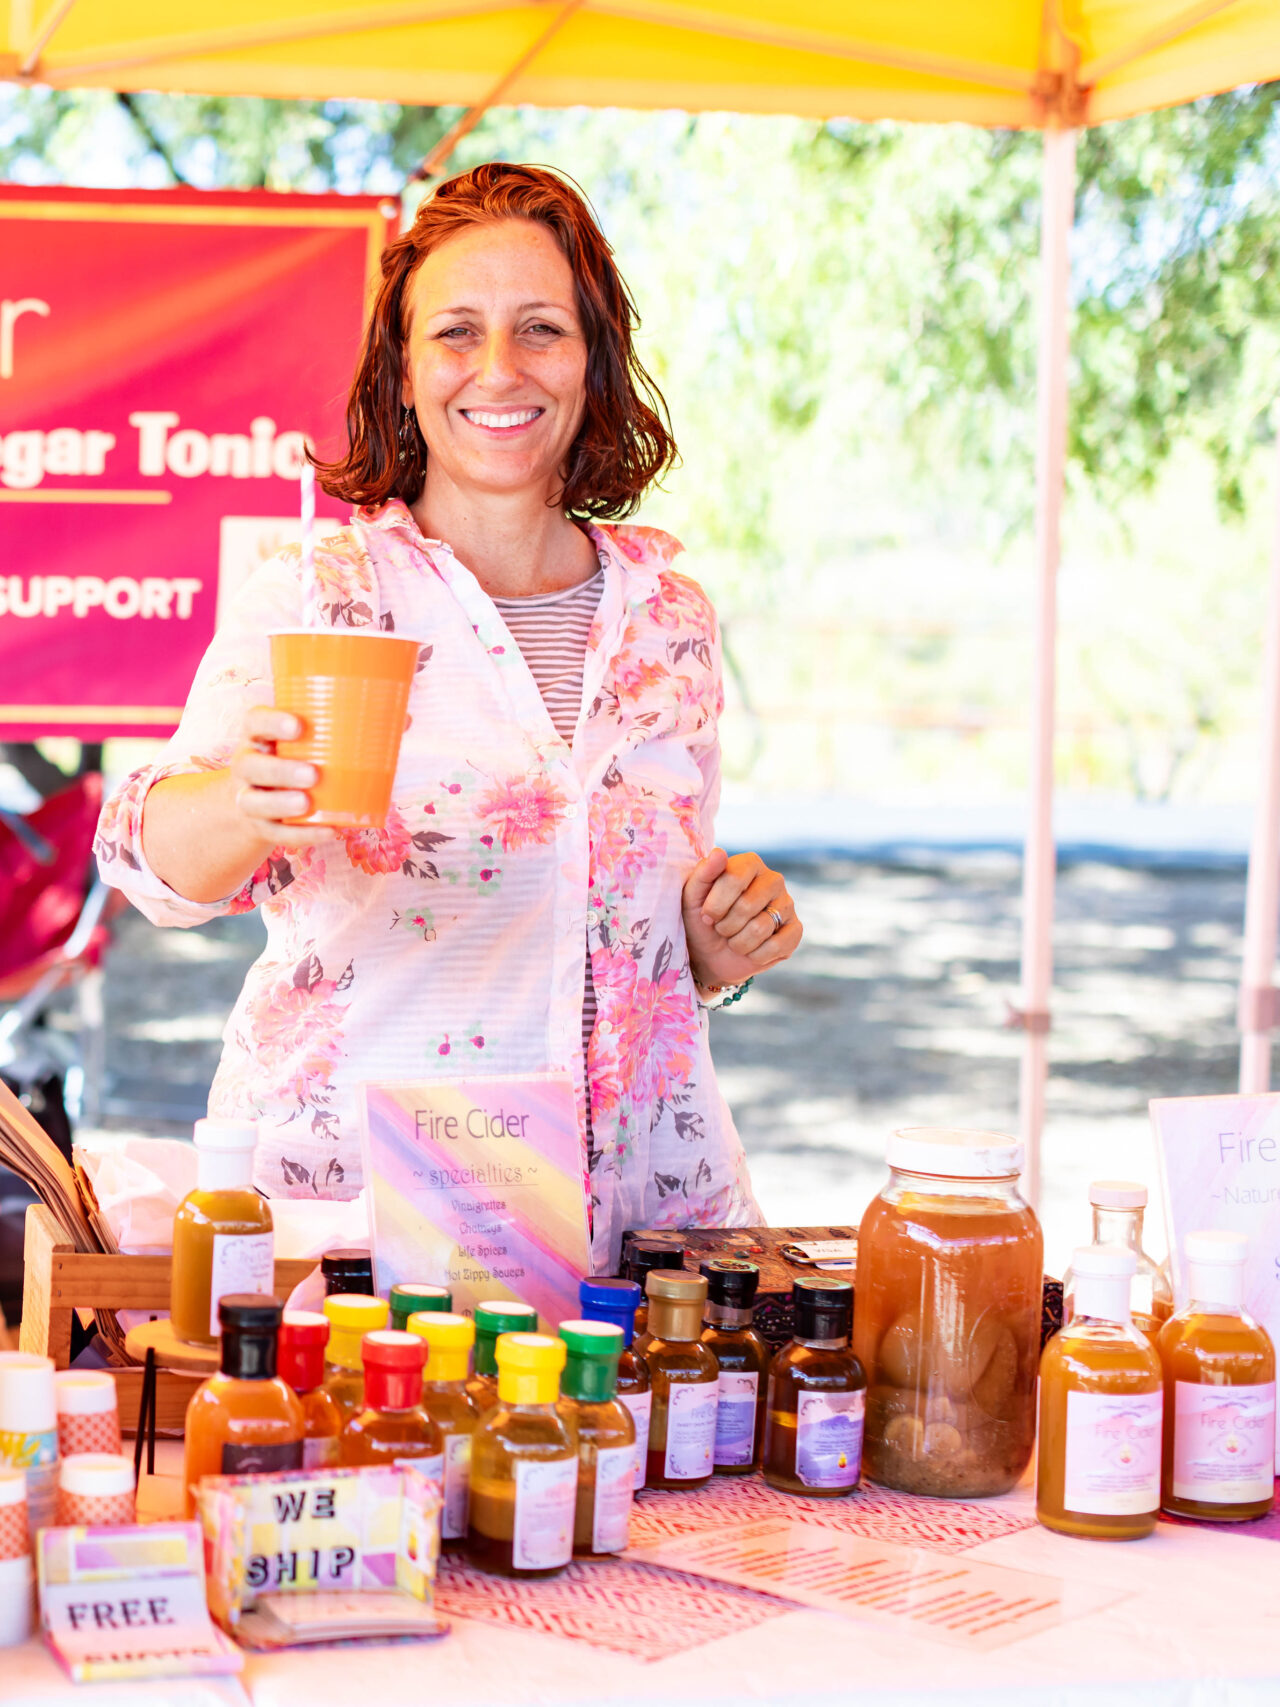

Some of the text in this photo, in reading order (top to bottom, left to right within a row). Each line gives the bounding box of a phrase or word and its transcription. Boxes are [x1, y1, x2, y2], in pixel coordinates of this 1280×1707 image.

[129, 411, 315, 479] Tonic
[415, 1108, 530, 1140] Fire Cider
[1218, 1131, 1277, 1164] Fire
[428, 1162, 523, 1189] specialties
[273, 1488, 336, 1523] WE
[245, 1546, 355, 1587] SHIP
[67, 1597, 175, 1631] FREE
